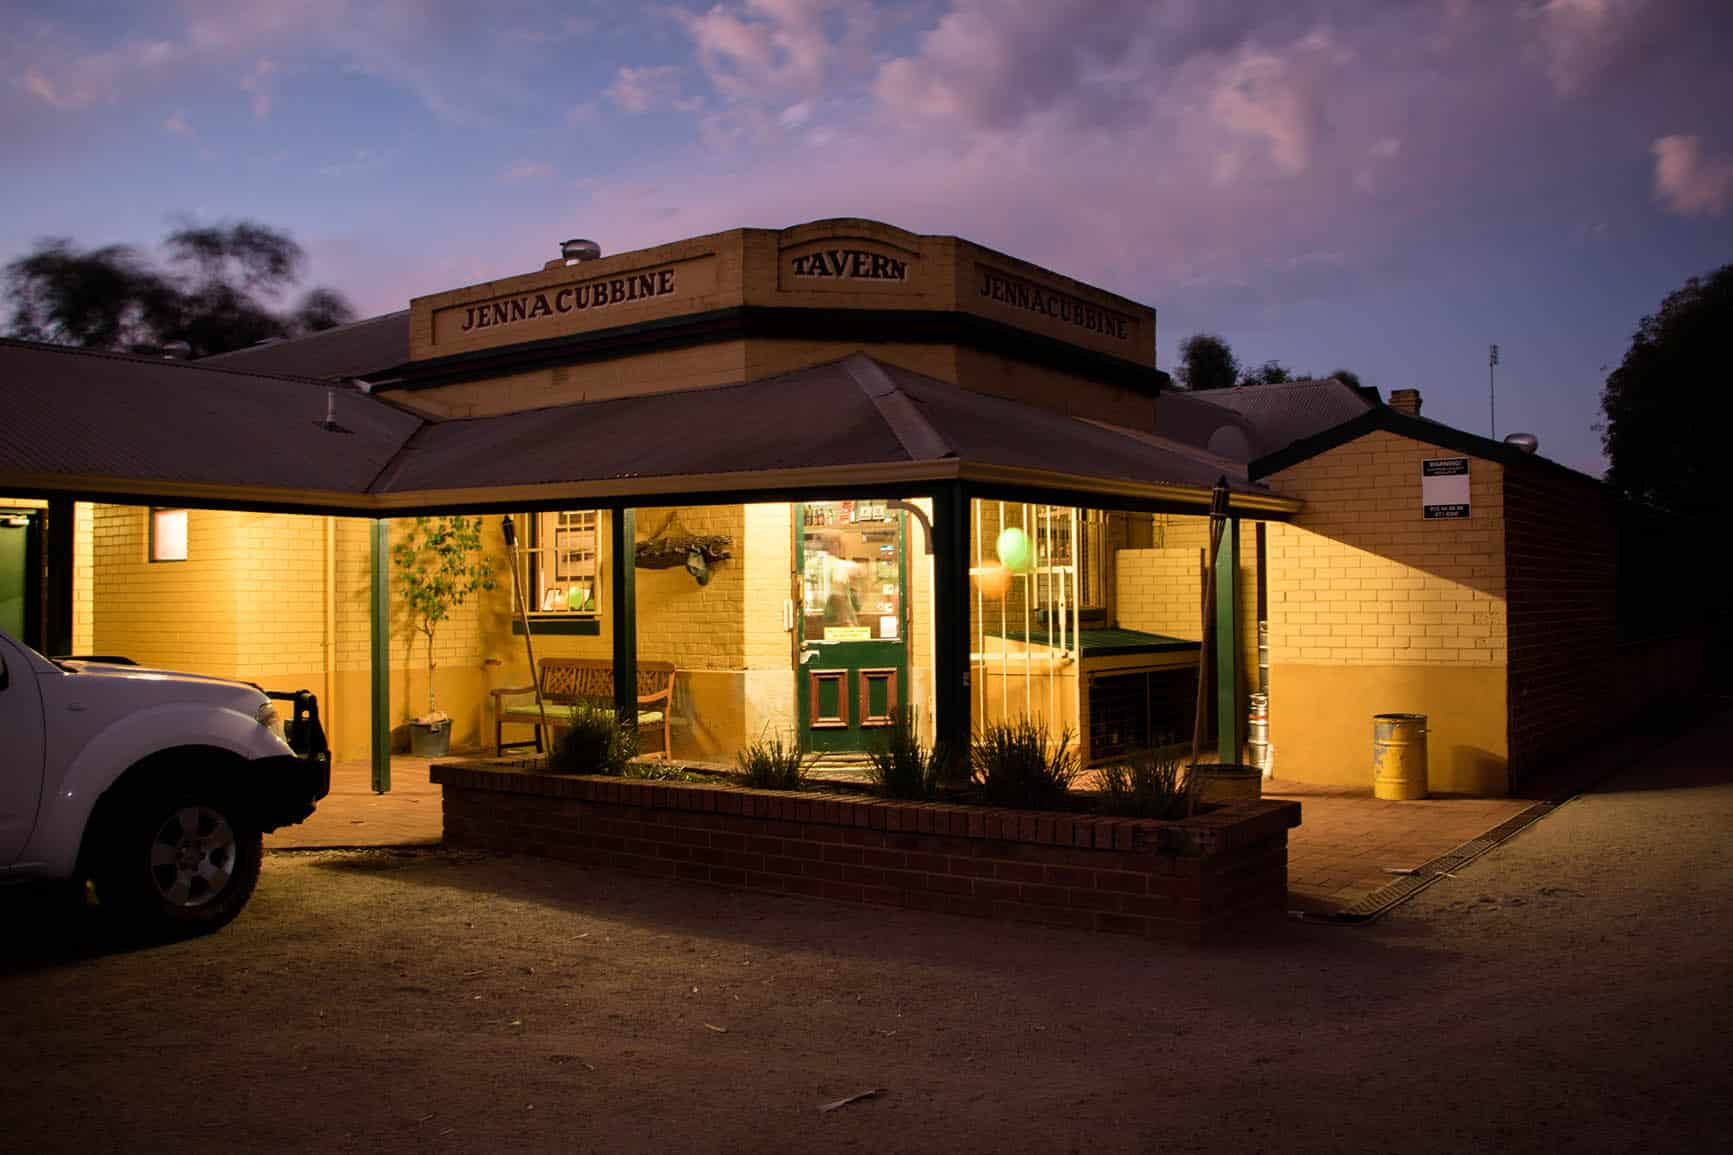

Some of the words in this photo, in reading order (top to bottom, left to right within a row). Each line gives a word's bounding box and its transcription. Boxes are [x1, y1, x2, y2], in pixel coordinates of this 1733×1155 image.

[792, 250, 907, 280] TAVERN
[461, 270, 675, 331] JENNACUBBINE
[981, 274, 1128, 339] JENNACUBBINE
